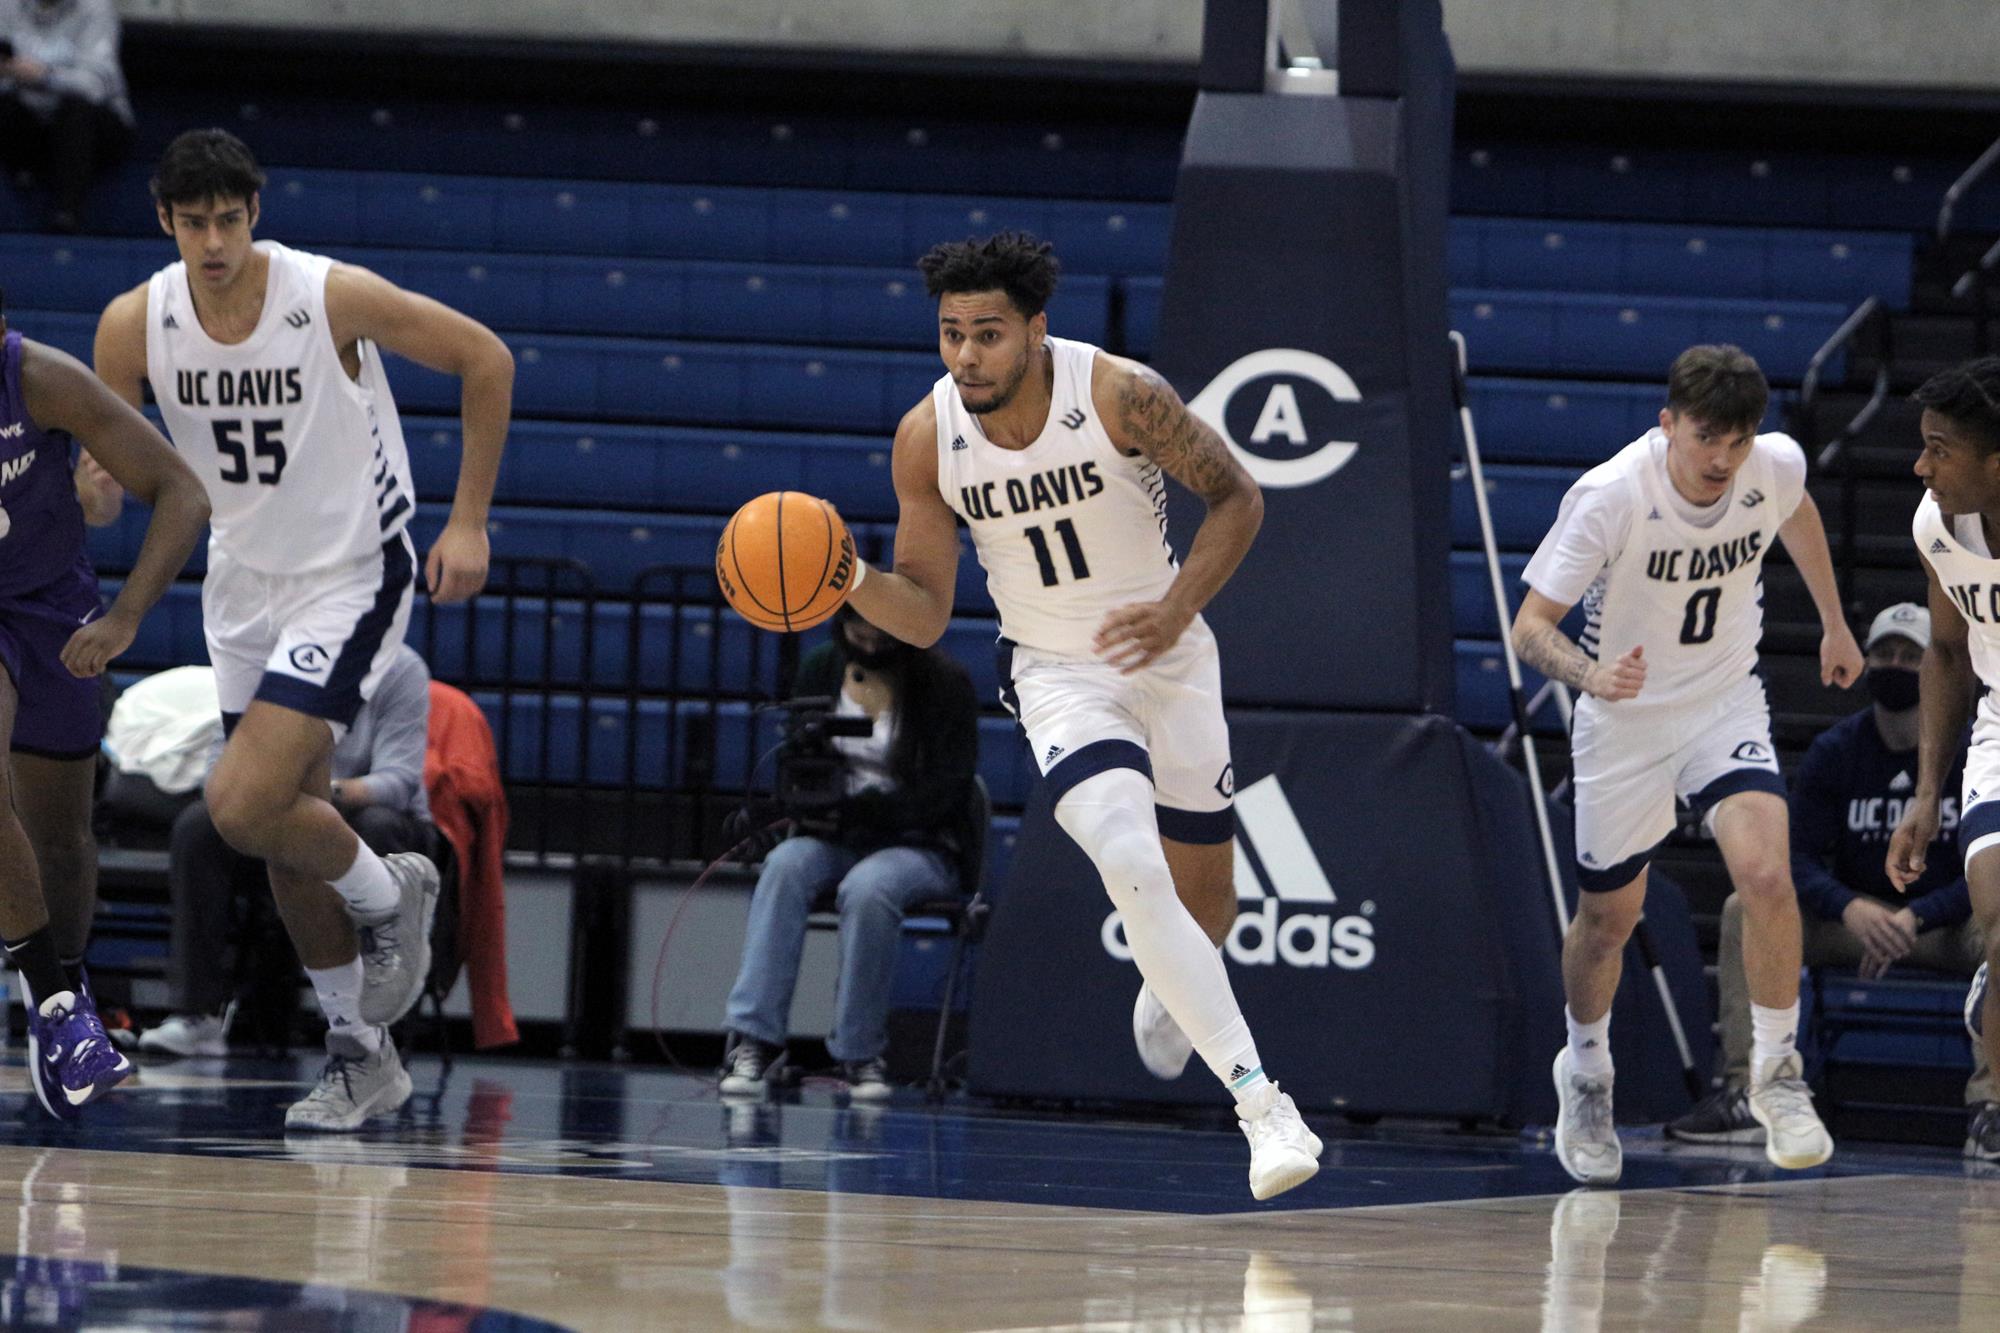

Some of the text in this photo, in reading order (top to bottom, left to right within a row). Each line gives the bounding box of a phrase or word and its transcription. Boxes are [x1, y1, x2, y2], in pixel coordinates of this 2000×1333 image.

[177, 366, 302, 407] UC DAVIS
[211, 419, 287, 485] 55
[961, 460, 1104, 520] UC DAVIS
[1023, 517, 1090, 587] 11
[1647, 529, 1761, 582] UC DAVIS
[1679, 586, 1722, 644] 0
[1848, 797, 1883, 832] UC
